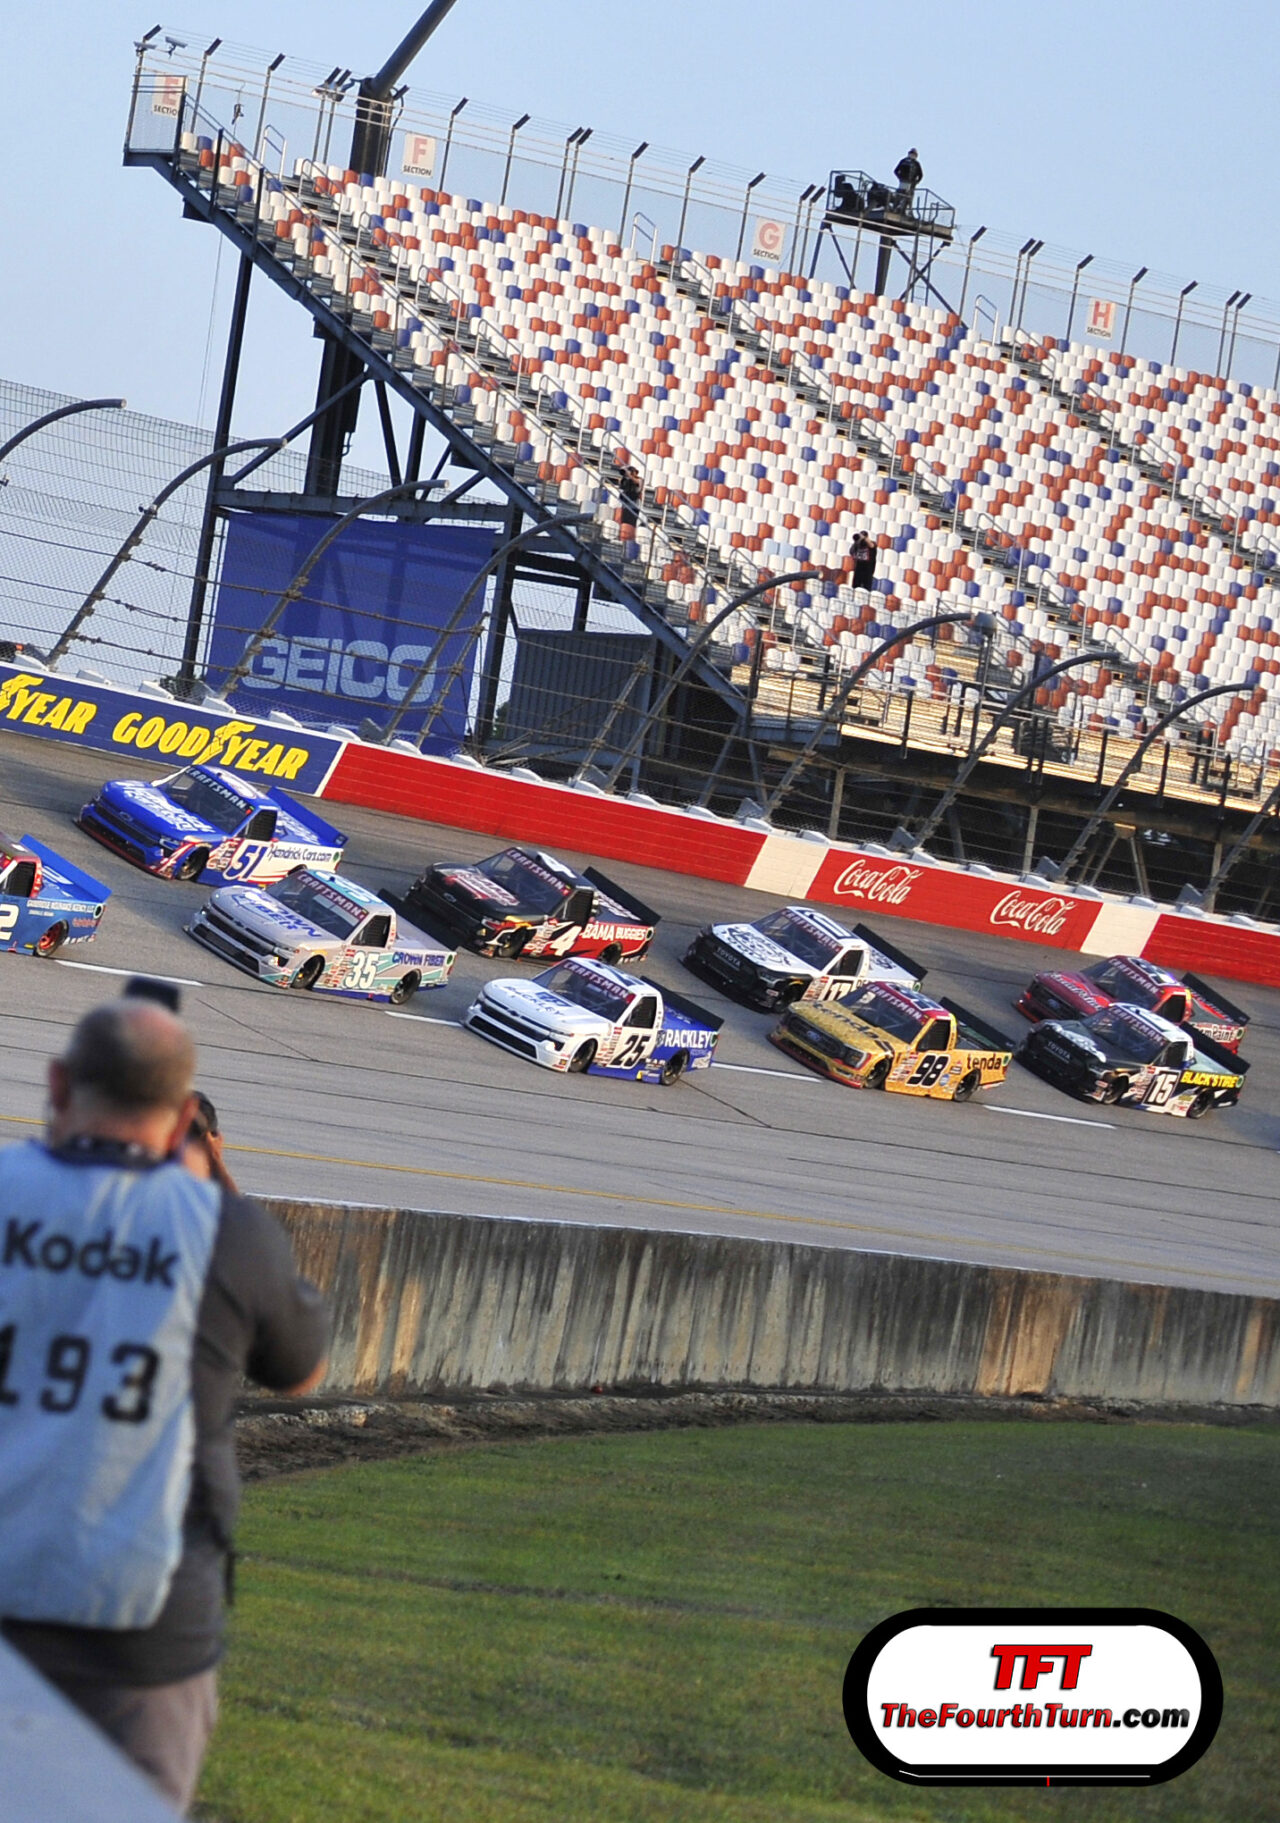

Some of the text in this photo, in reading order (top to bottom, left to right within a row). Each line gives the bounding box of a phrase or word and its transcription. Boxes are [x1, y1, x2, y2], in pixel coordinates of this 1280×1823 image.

[162, 76, 179, 106] E
[153, 105, 178, 116] SECTIO
[412, 137, 428, 164] F
[403, 165, 432, 176] SECTION
[759, 223, 780, 250] G
[753, 248, 780, 261] SECTION
[1092, 301, 1111, 329] H
[1087, 326, 1111, 338] SECTION
[241, 633, 437, 703] GEICO
[111, 711, 309, 780] GOODYEAR
[185, 768, 247, 810] CRAFTSMAN
[224, 844, 269, 880] 51
[506, 850, 565, 891] CRAFTSMAN
[297, 874, 361, 917] CRAFTSMAN
[549, 925, 582, 957] 4
[579, 921, 647, 941] BAMA BUGGIES
[344, 951, 380, 990] 35
[392, 951, 446, 967] CROWN FIBER
[563, 961, 628, 999] CRAFTSMAN
[1108, 958, 1159, 995] CRAFTSMAN
[866, 983, 922, 1020] CRAFTSMAN
[664, 1028, 712, 1049] RACKLEY
[1108, 1007, 1163, 1044] CRAFTSMAN
[609, 1034, 651, 1067] 25
[966, 1052, 1002, 1070] tenda
[1046, 1040, 1071, 1059] TOYOTA
[906, 1054, 950, 1087] 98
[1147, 1073, 1178, 1104] 15
[2, 1217, 178, 1289] Kodak
